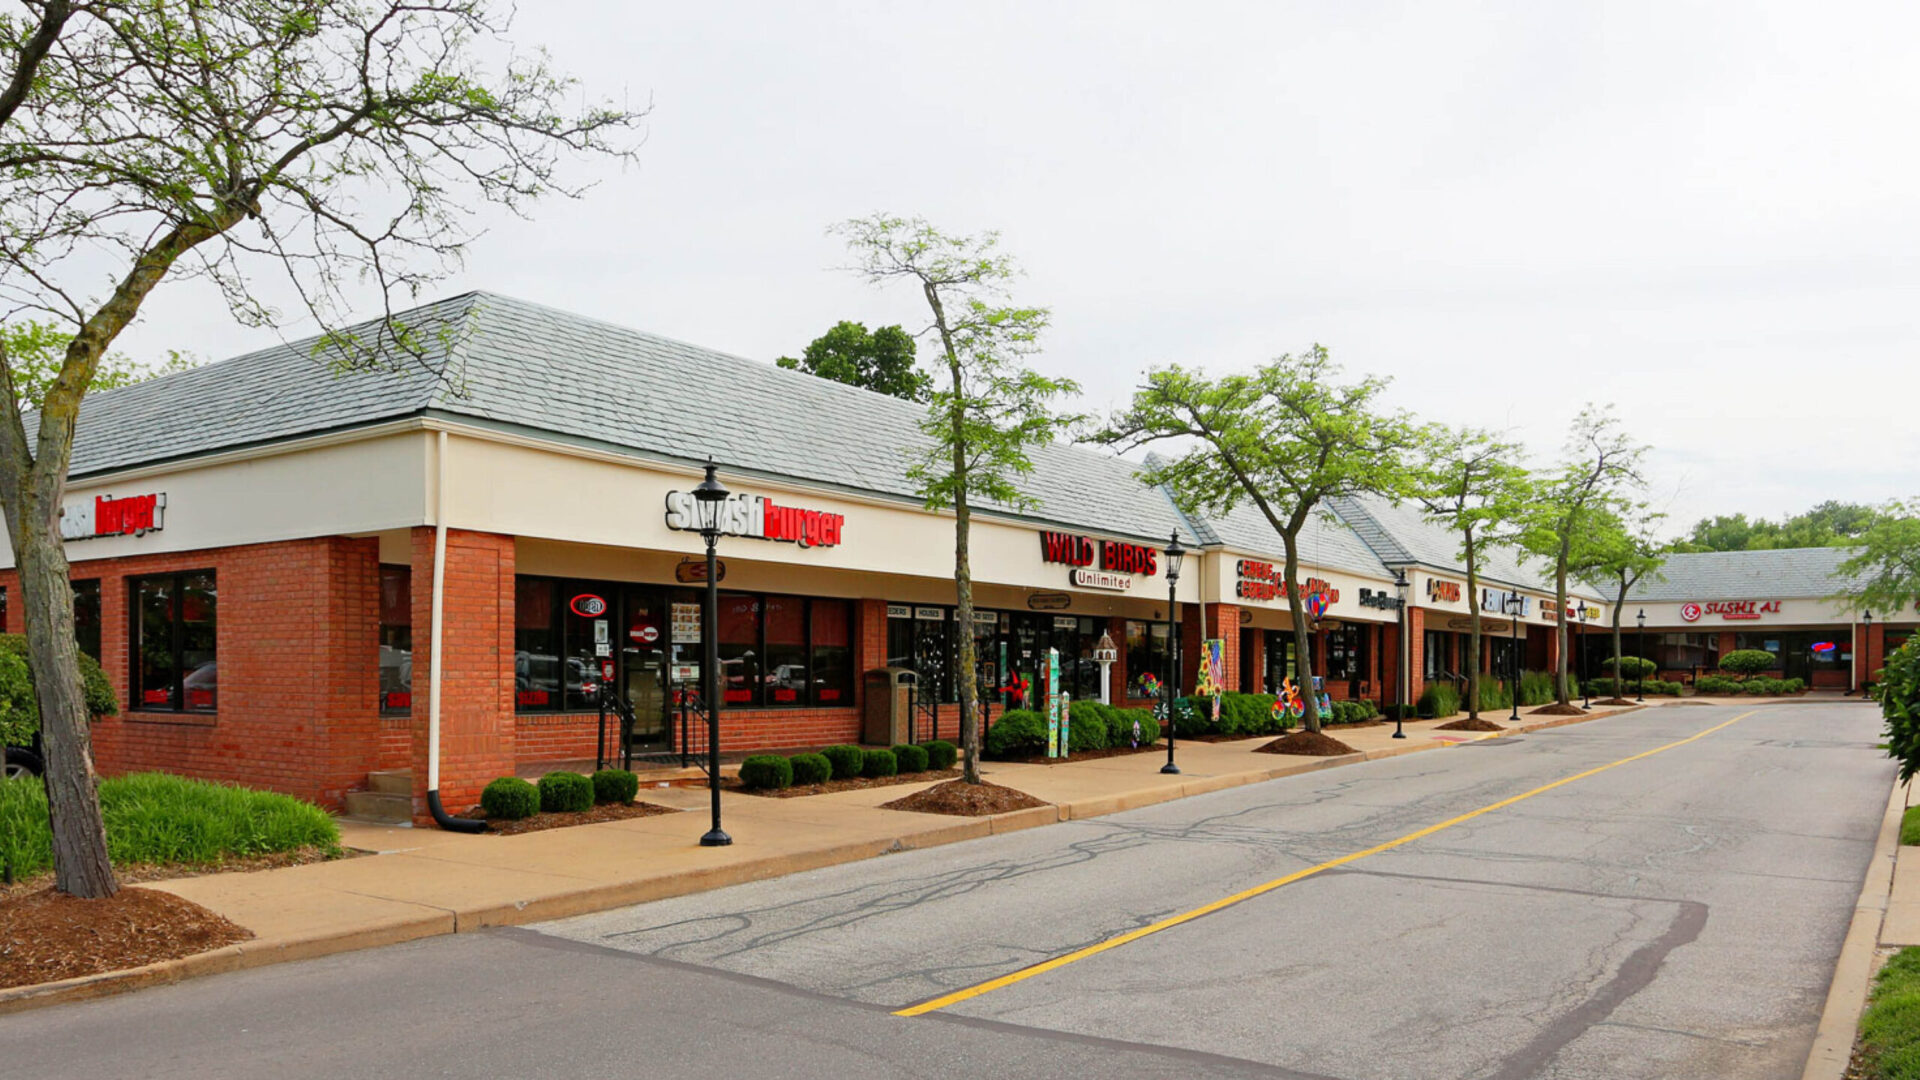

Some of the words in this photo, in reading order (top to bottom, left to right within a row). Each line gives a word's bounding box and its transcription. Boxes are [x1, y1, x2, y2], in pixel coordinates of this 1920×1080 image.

[1041, 531, 1094, 568] WILD
[1100, 540, 1157, 577] BIRDS
[1078, 571, 1131, 589] Unlimited
[1704, 601, 1756, 615] SUSHI
[1760, 600, 1782, 614] AI
